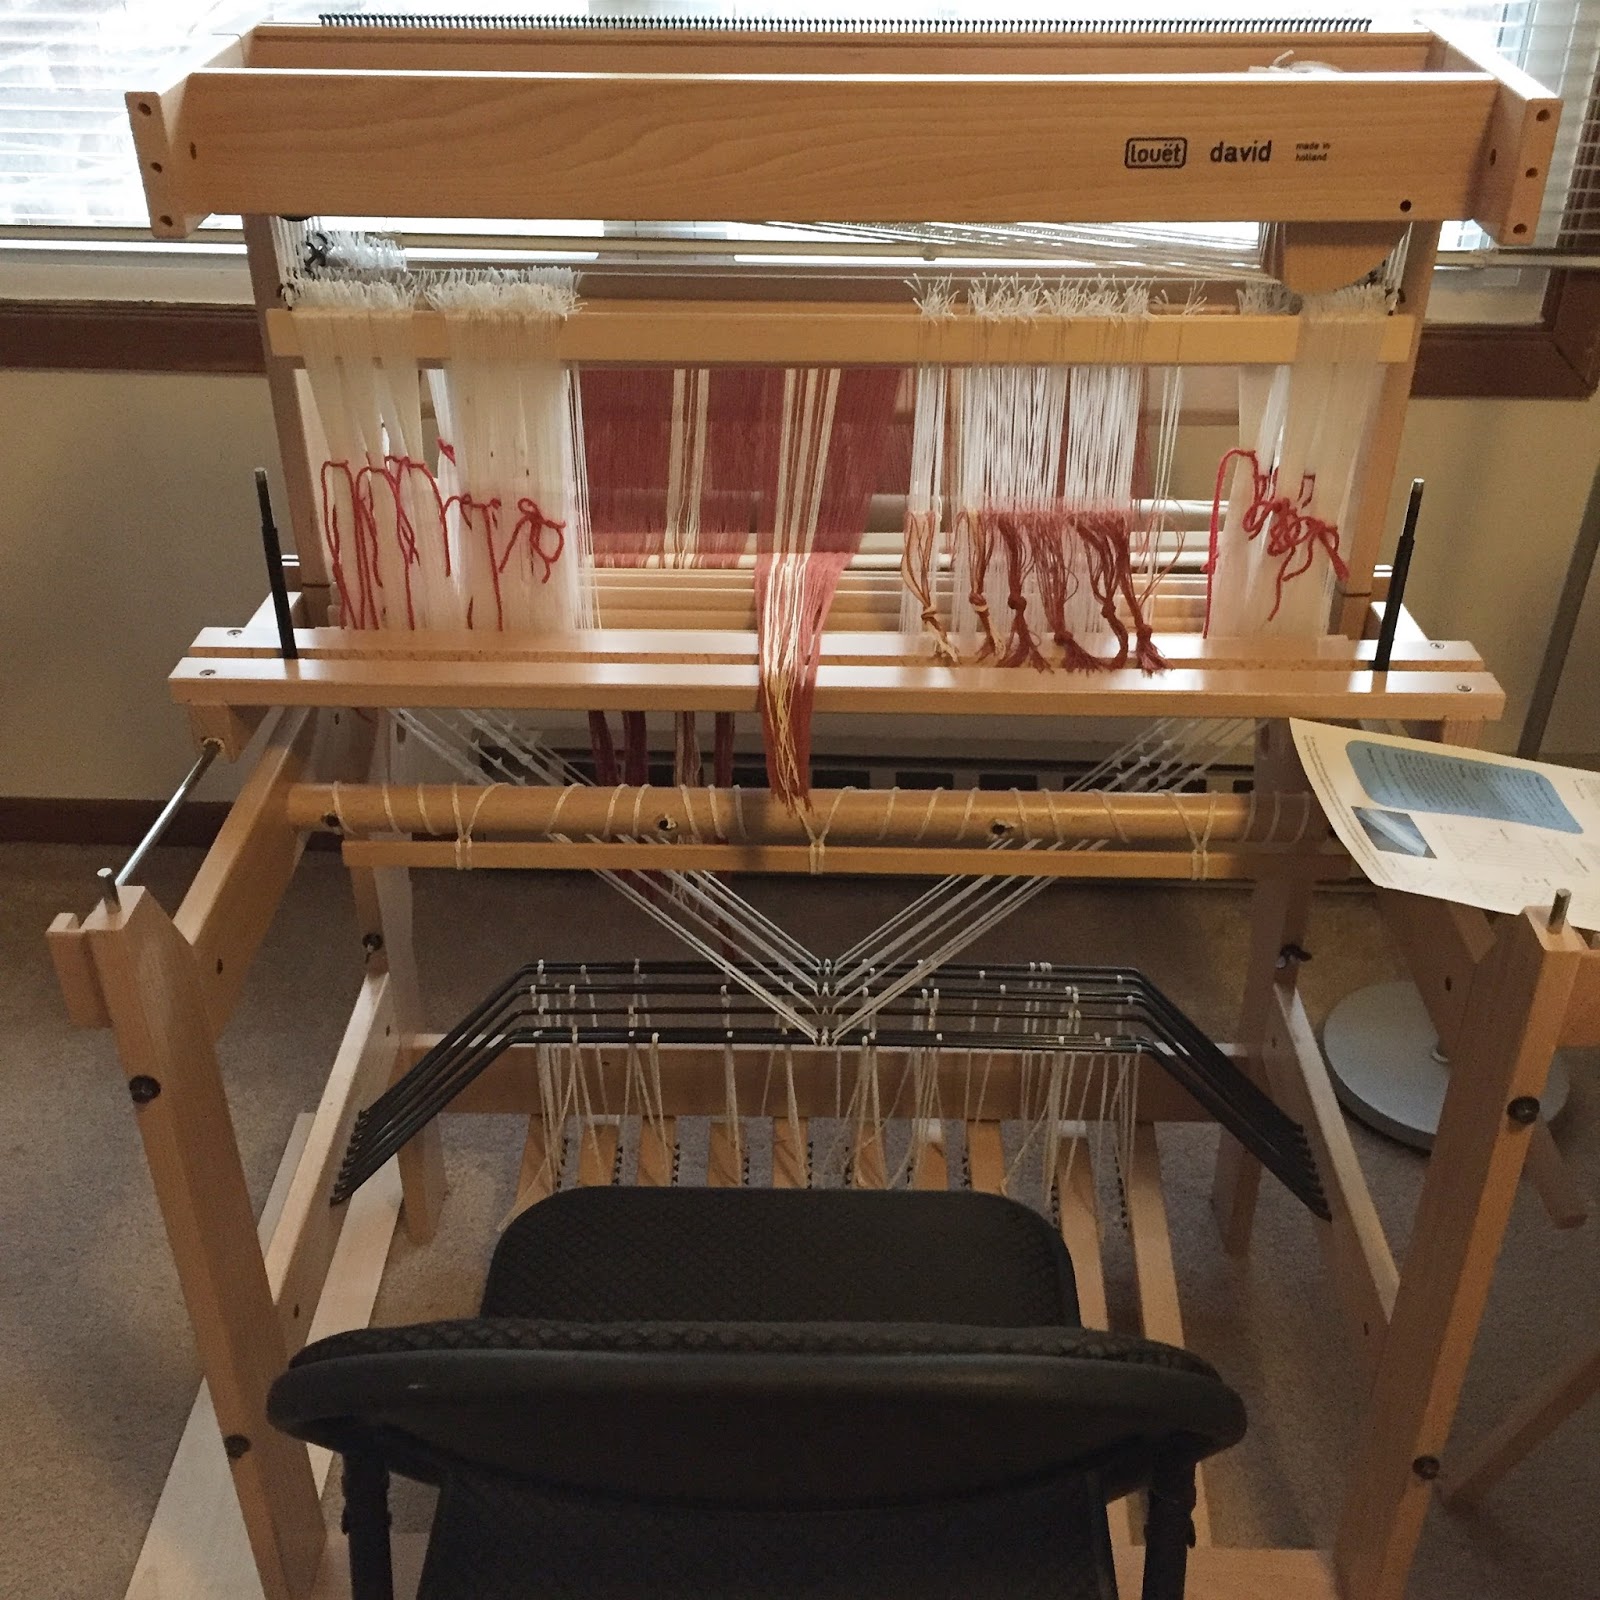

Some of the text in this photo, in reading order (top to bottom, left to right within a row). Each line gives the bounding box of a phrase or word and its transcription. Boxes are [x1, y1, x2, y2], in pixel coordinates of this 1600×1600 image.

[1130, 143, 1182, 163] louët
[1210, 140, 1272, 162] david
[1296, 142, 1331, 150] made in
[1295, 152, 1328, 161] holland
